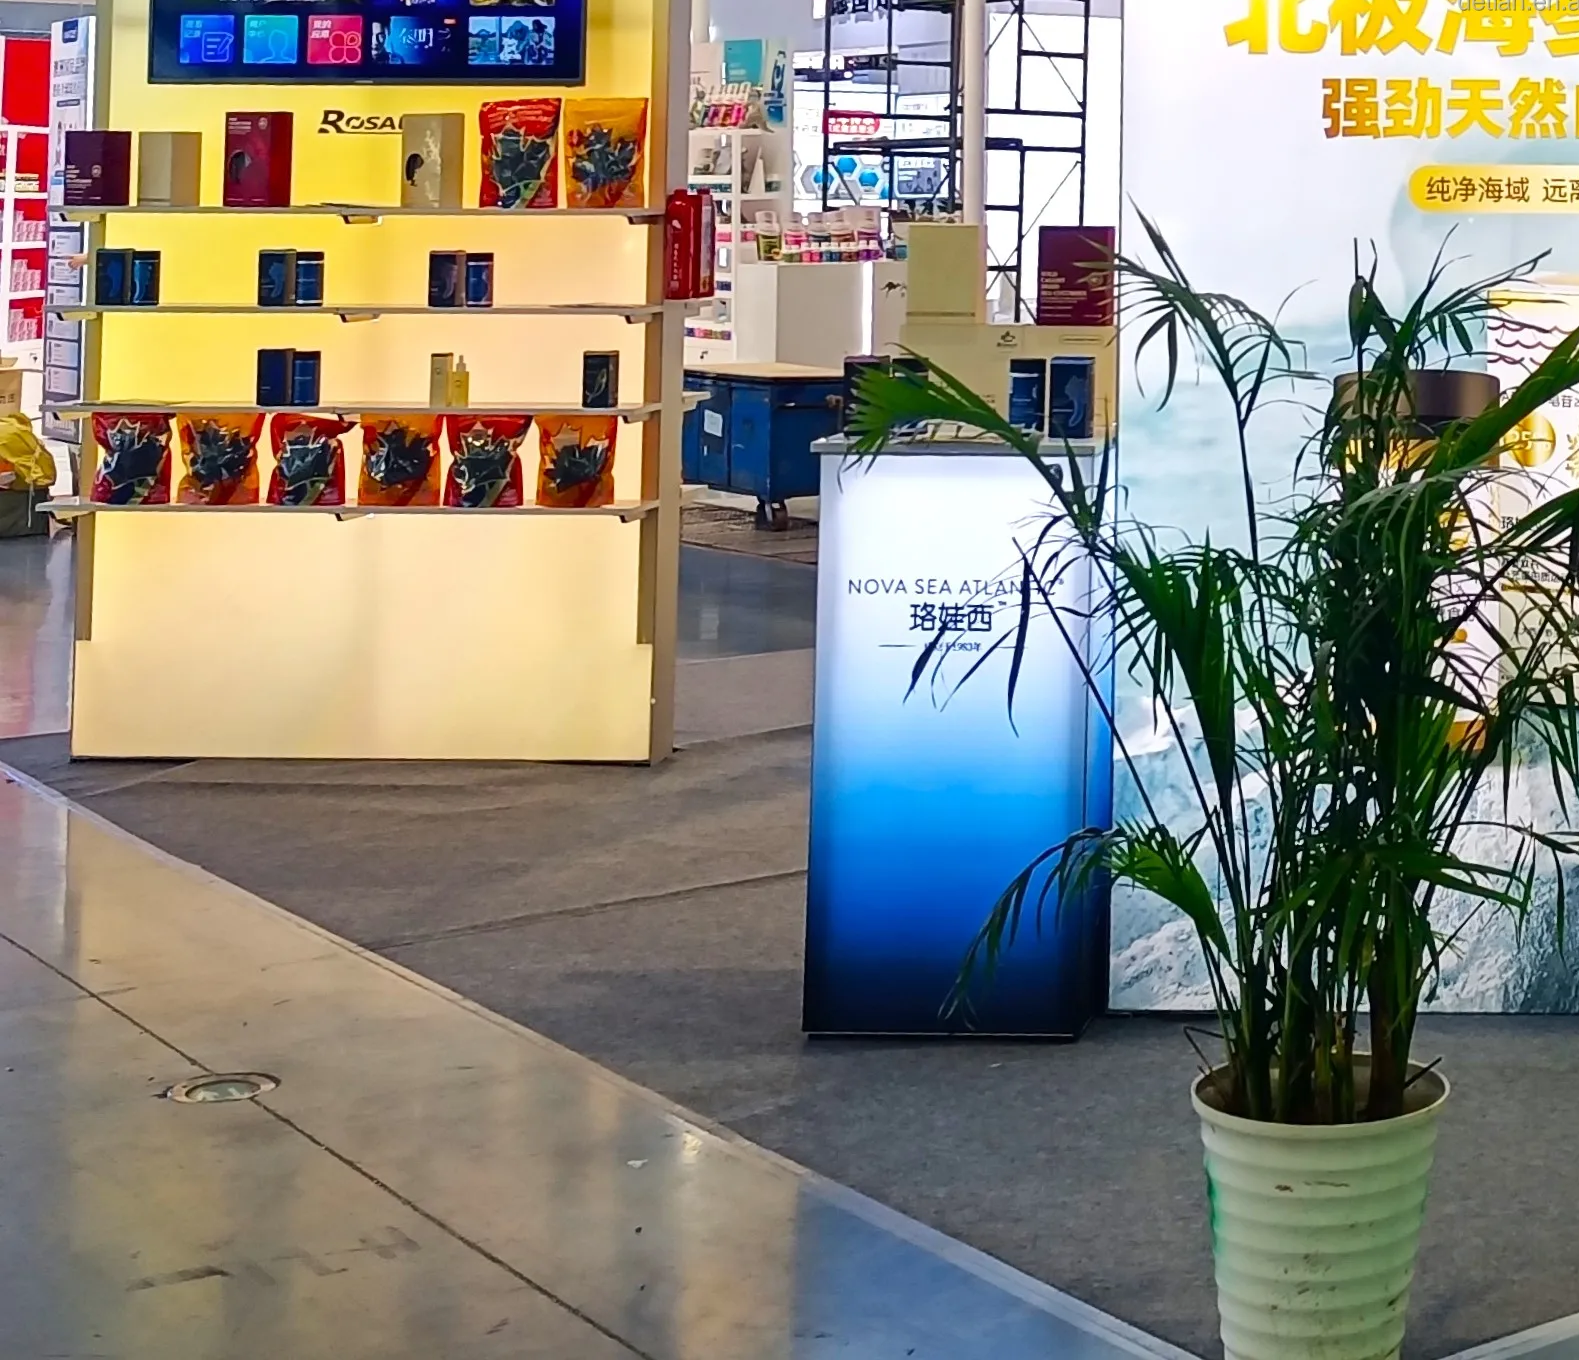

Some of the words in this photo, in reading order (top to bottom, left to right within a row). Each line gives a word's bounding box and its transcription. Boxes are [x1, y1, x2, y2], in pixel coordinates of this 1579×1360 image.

[1424, 176, 1530, 204] 纯净海域
[848, 578, 908, 595] NOVA
[914, 578, 953, 595] SEA
